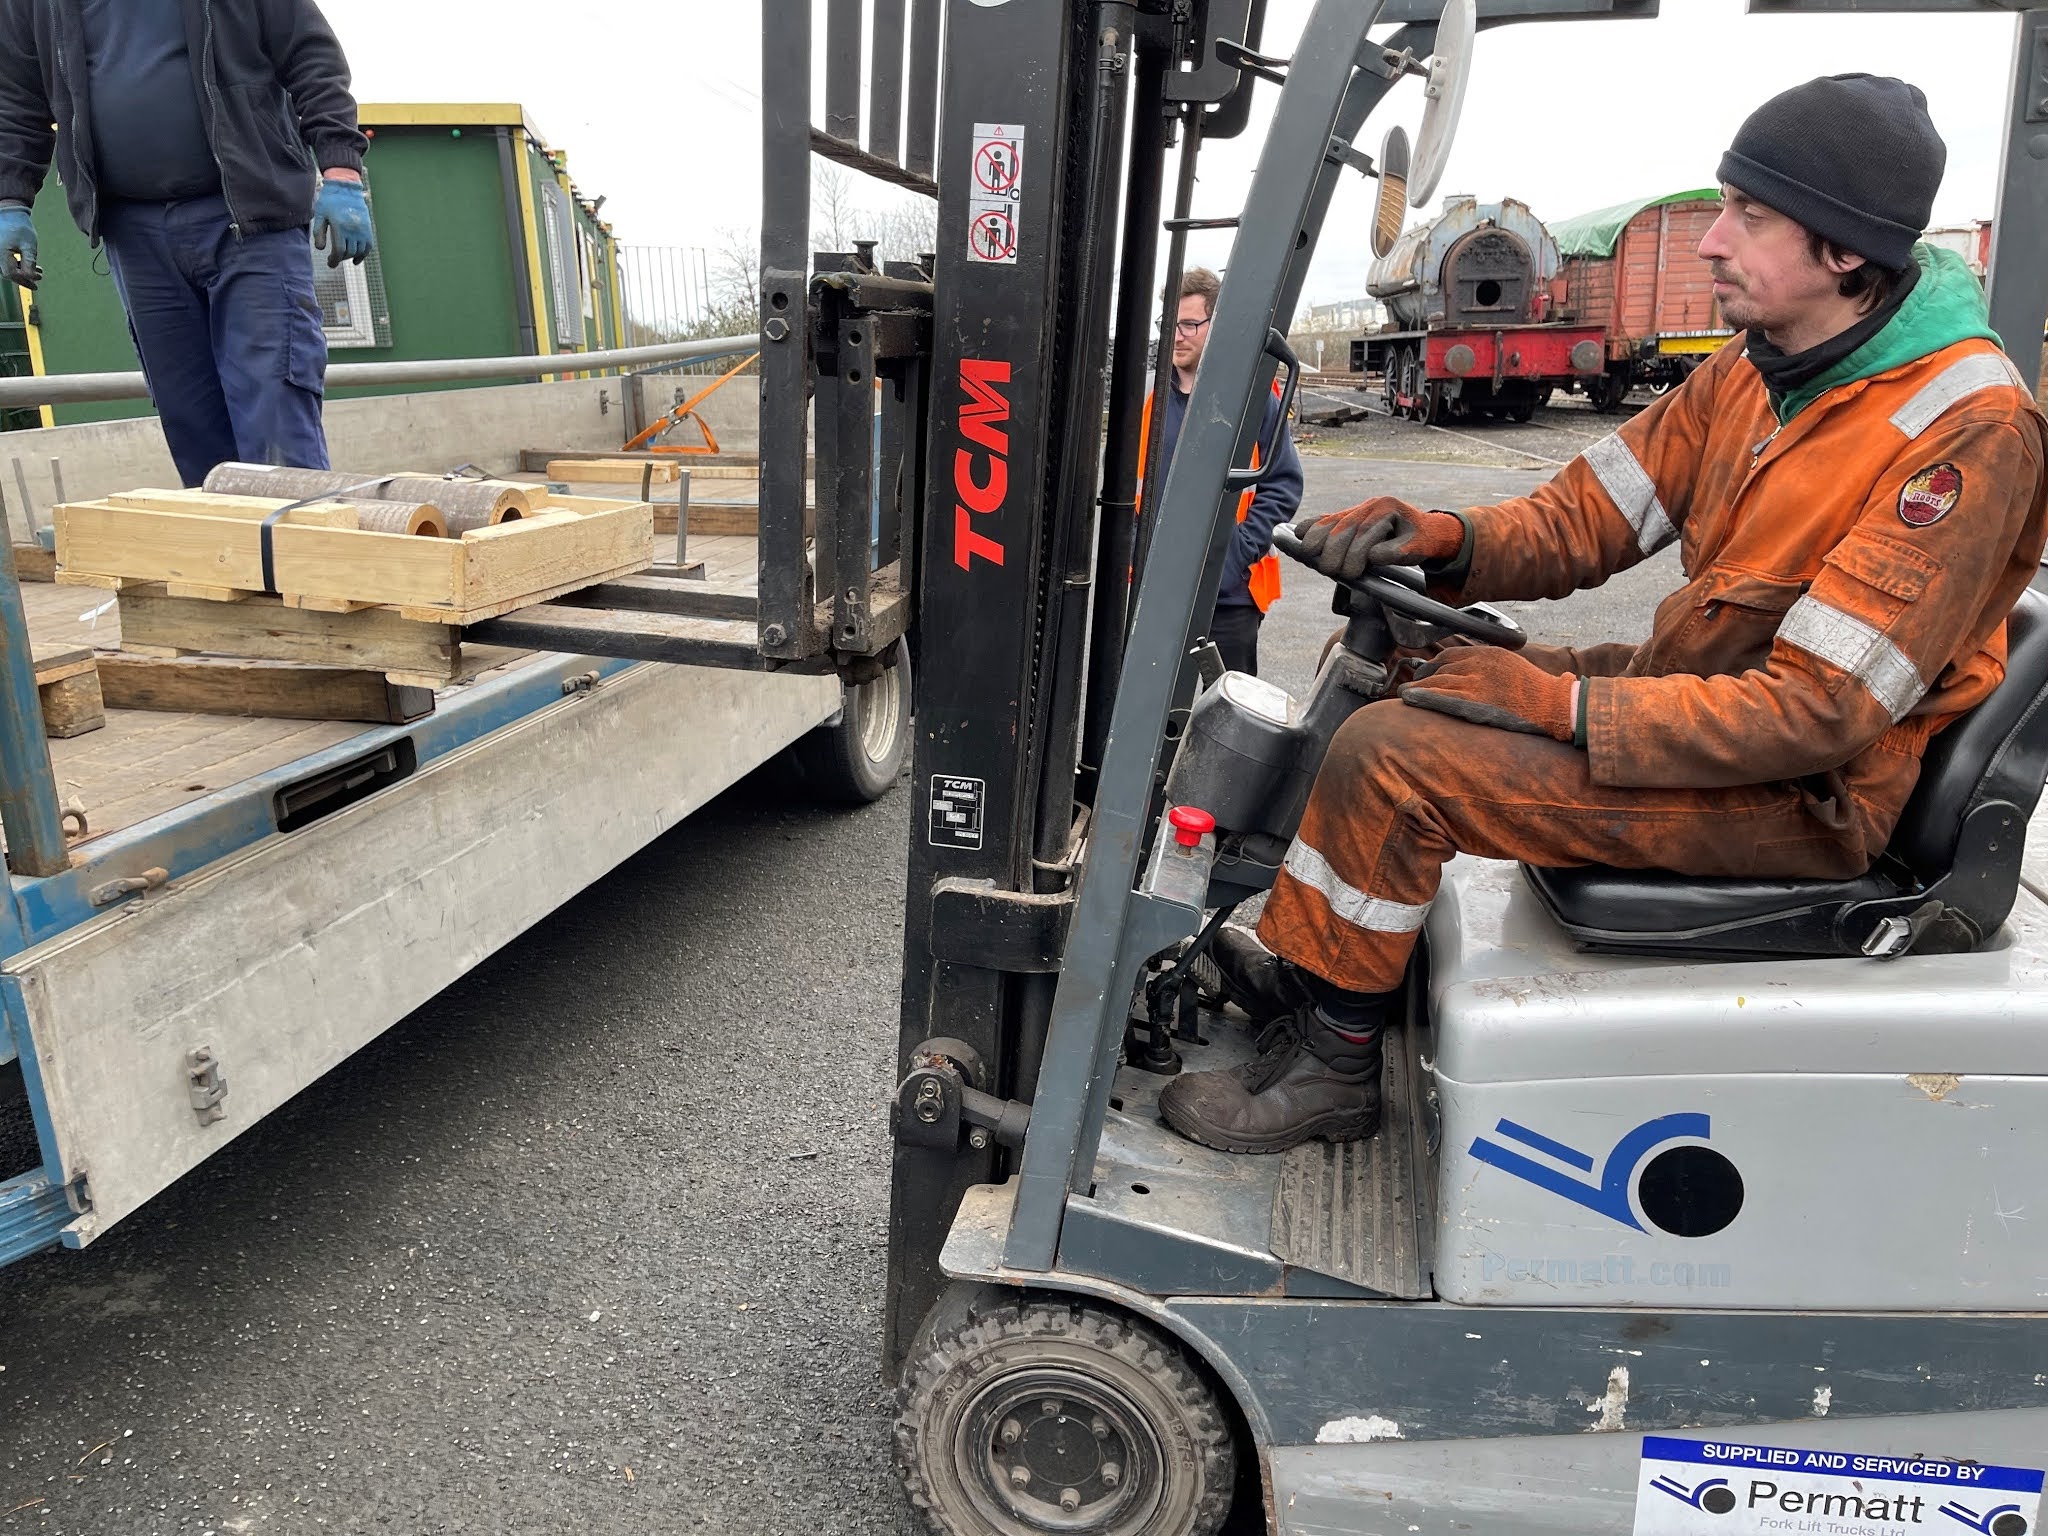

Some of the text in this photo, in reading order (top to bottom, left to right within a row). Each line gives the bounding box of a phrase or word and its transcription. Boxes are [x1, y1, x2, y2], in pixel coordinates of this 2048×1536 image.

[954, 359, 1011, 572] TCM
[943, 780, 973, 791] TCM
[1482, 1253, 1732, 1287] Permatt.com
[1702, 1443, 1985, 1481] SUPPLIED AND SERVICED BY
[1747, 1480, 1926, 1524] Permatt
[1759, 1516, 1906, 1536] Fork Lift Trucks Ltd
